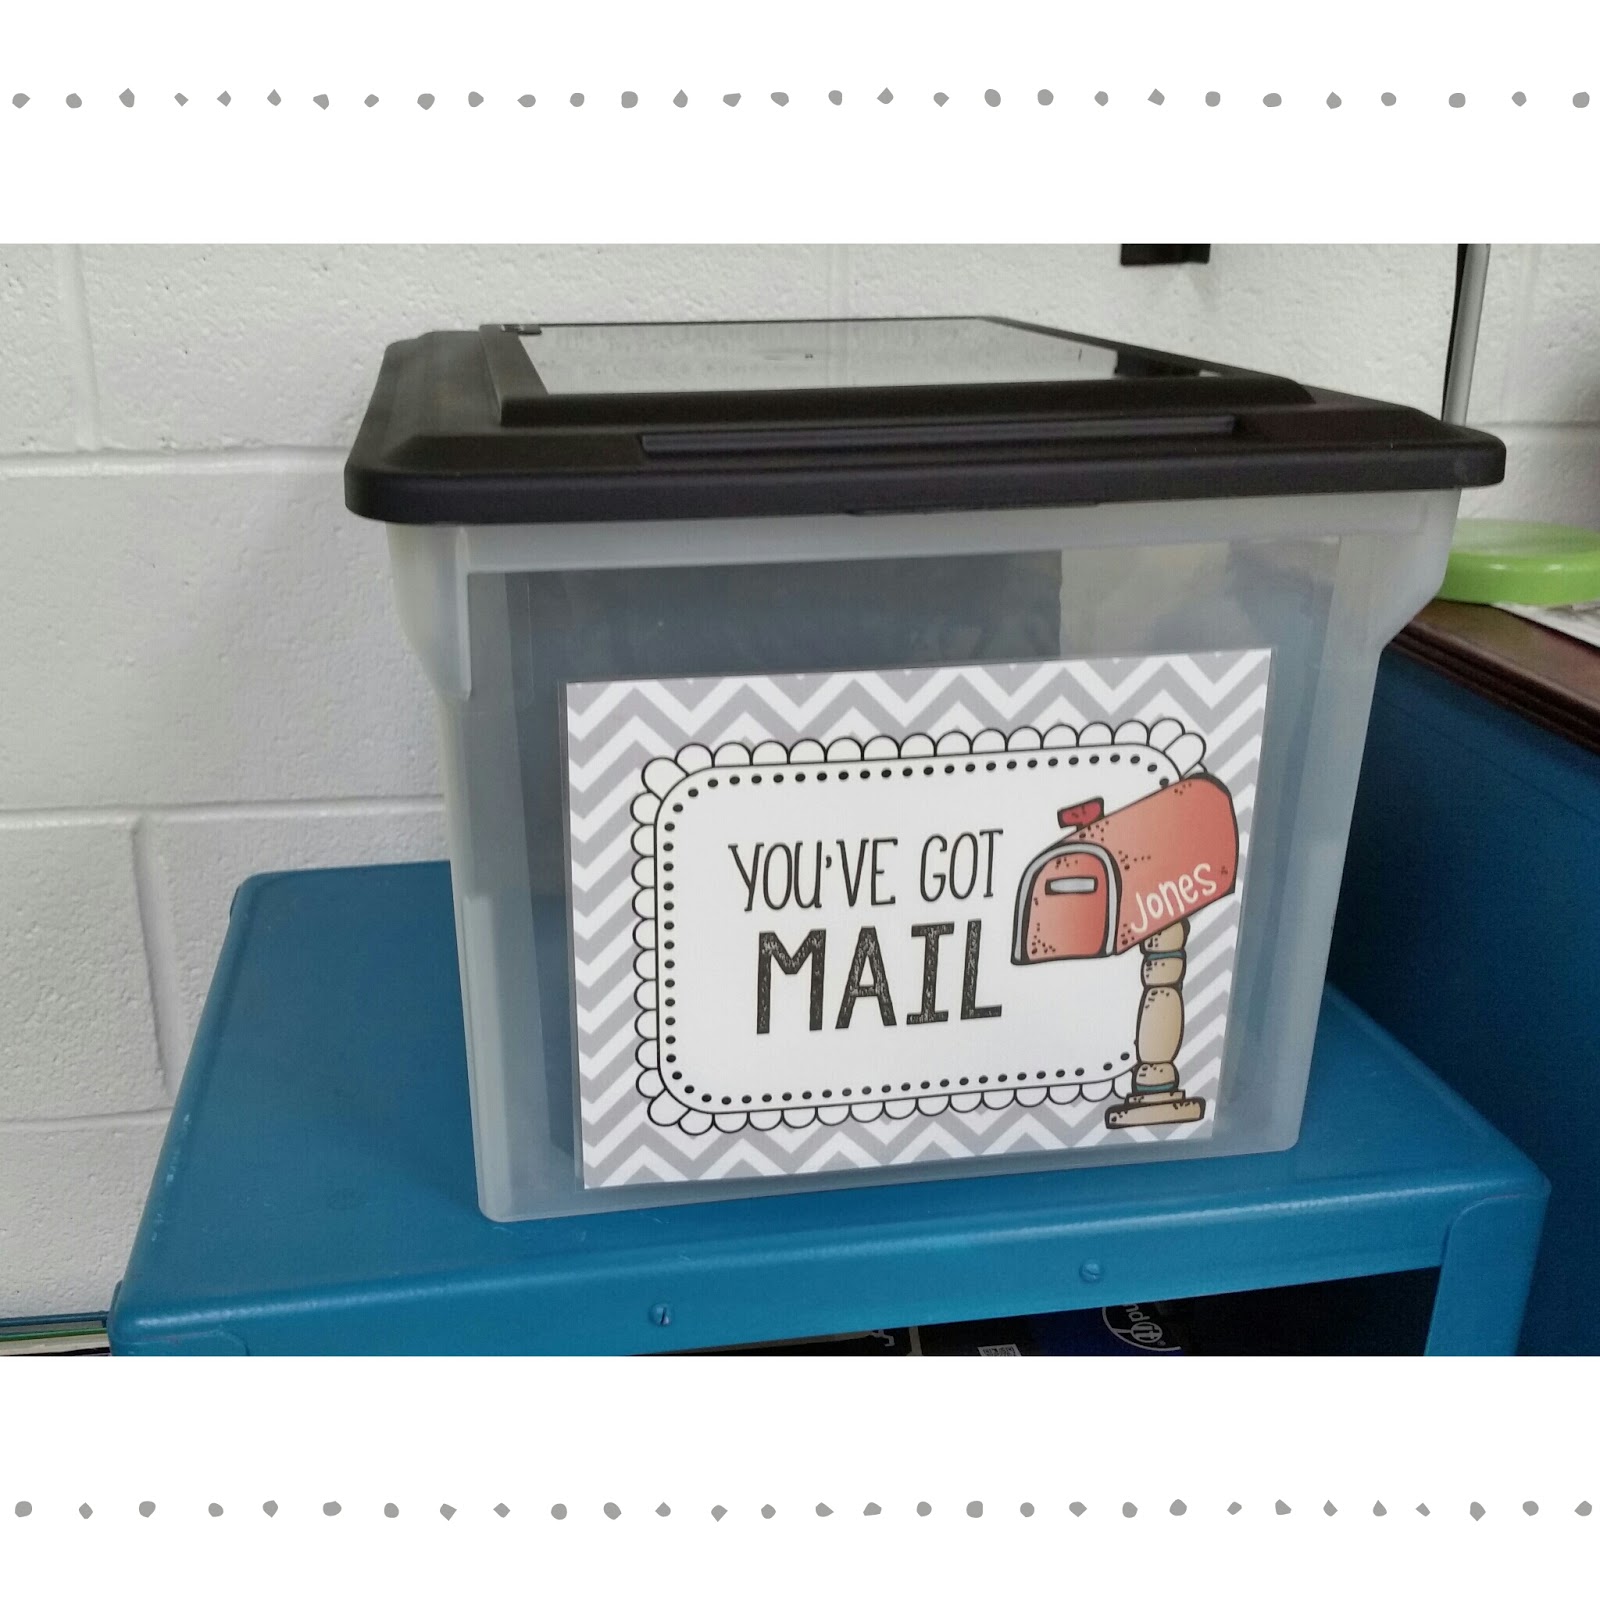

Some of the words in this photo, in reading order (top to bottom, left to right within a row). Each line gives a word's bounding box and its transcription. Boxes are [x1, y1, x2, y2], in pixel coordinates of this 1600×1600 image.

[728, 837, 898, 912] YOU'VE
[919, 829, 1003, 902] GOT
[1130, 863, 1217, 933] Jones
[756, 919, 1003, 1035] MAIL
